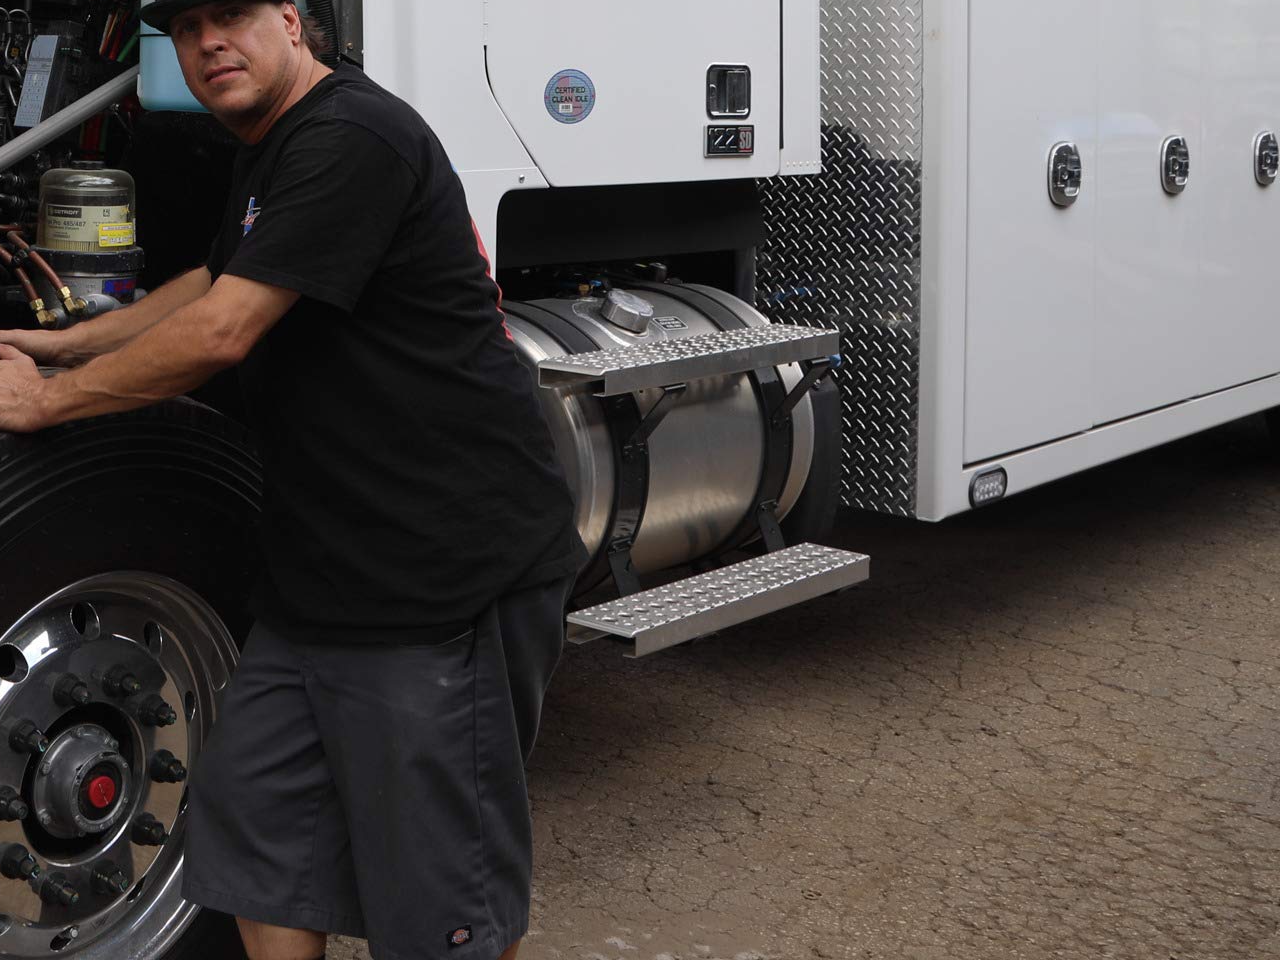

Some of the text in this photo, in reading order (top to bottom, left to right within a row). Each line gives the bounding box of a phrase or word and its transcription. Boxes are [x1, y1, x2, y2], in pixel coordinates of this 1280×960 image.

[555, 86, 586, 94] CERTIFIED
[552, 95, 589, 103] CLEAN IDLE
[739, 131, 752, 149] SD
